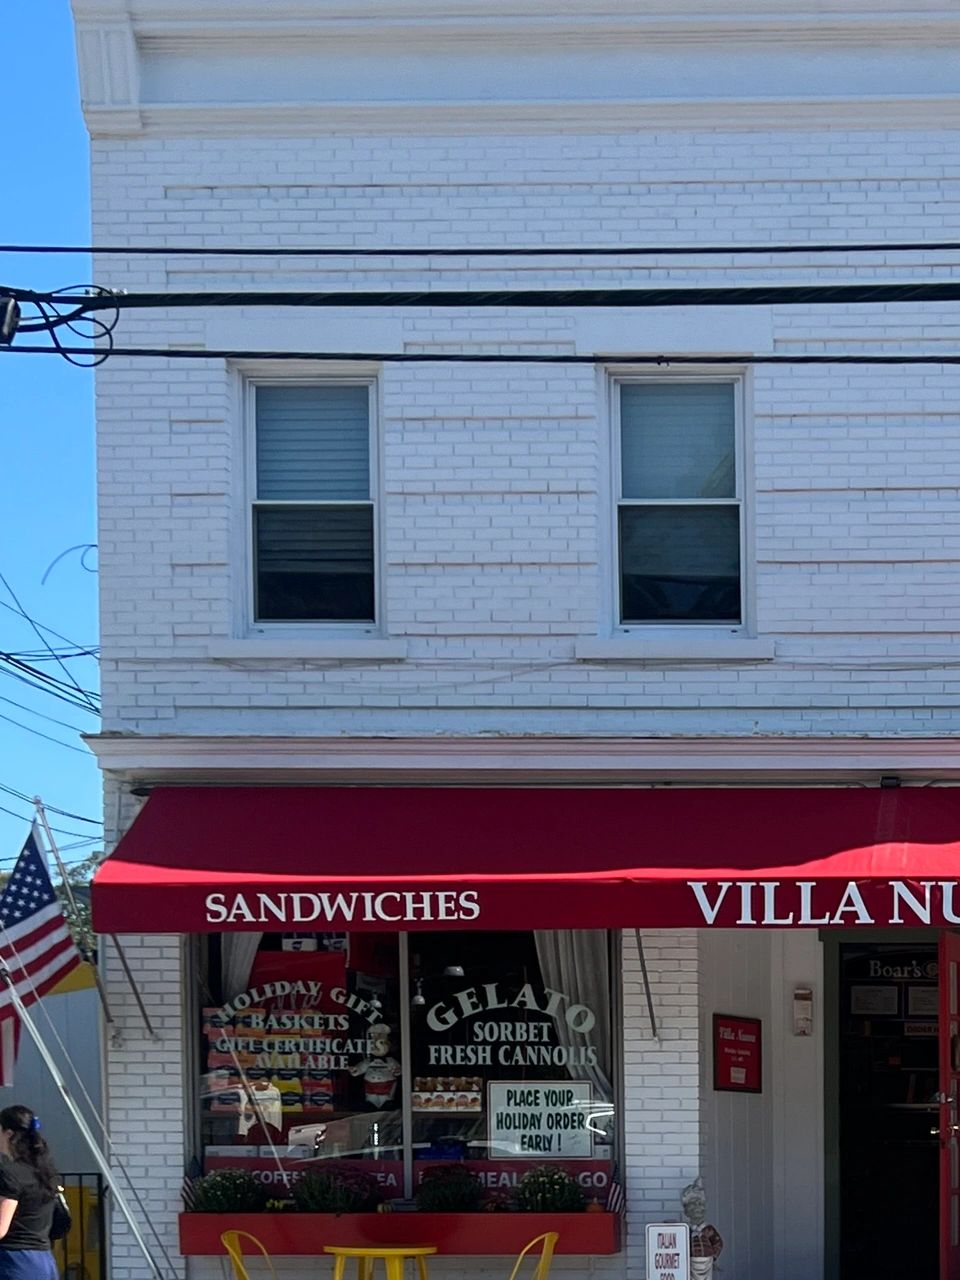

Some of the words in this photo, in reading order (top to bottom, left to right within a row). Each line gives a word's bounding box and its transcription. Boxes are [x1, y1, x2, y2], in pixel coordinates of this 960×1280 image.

[205, 890, 481, 923] SANDWICHES
[687, 881, 875, 925] VILLA
[868, 960, 922, 978] Boar's
[216, 980, 323, 1023] HOLIDAY
[330, 987, 383, 1025] GIFT
[426, 982, 596, 1033] GELATO
[251, 1014, 350, 1031] BASKETS
[473, 1021, 552, 1042] SORBET
[263, 1038, 386, 1054] CERTIFICATES
[428, 1044, 492, 1066] FRESH
[498, 1044, 597, 1066] CANNOLIS
[255, 1055, 350, 1070] AVAILABLE
[506, 1089, 540, 1107] PLACE
[544, 1089, 575, 1107] YOUR
[496, 1112, 542, 1131] HOLIDAY
[546, 1112, 586, 1131] ORDER
[520, 1133, 554, 1152] EARLY
[577, 1172, 608, 1187] GO
[654, 1253, 680, 1270] GOURMET
